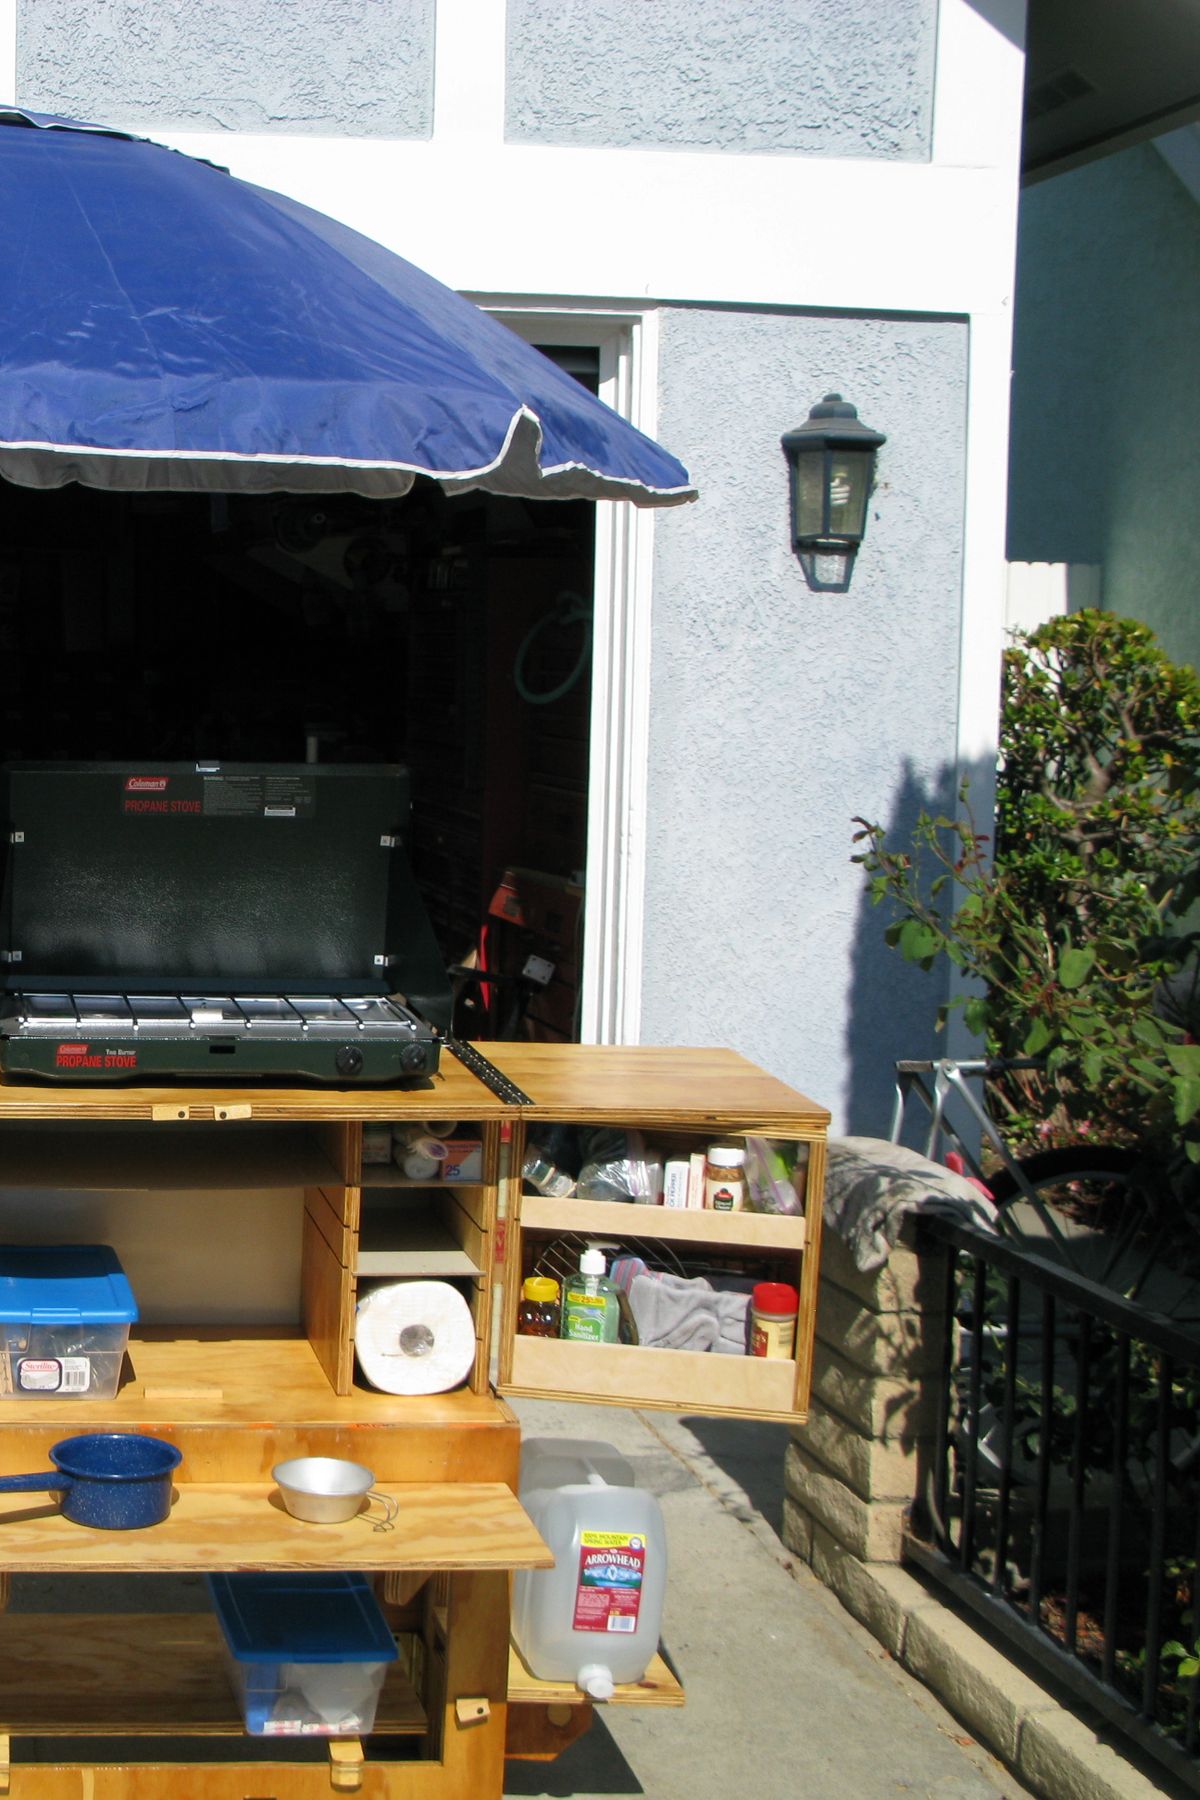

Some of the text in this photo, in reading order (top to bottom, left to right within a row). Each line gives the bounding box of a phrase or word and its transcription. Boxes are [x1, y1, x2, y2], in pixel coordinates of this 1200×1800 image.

[128, 778, 159, 788] Coleman
[125, 800, 201, 813] PROPANE STOVE
[56, 1055, 137, 1068] PROPANE STOVE
[446, 1164, 461, 1177] 25
[574, 1322, 593, 1333] Hand
[25, 1361, 56, 1370] Sterilite
[585, 1553, 640, 1568] ARROWHEAD
